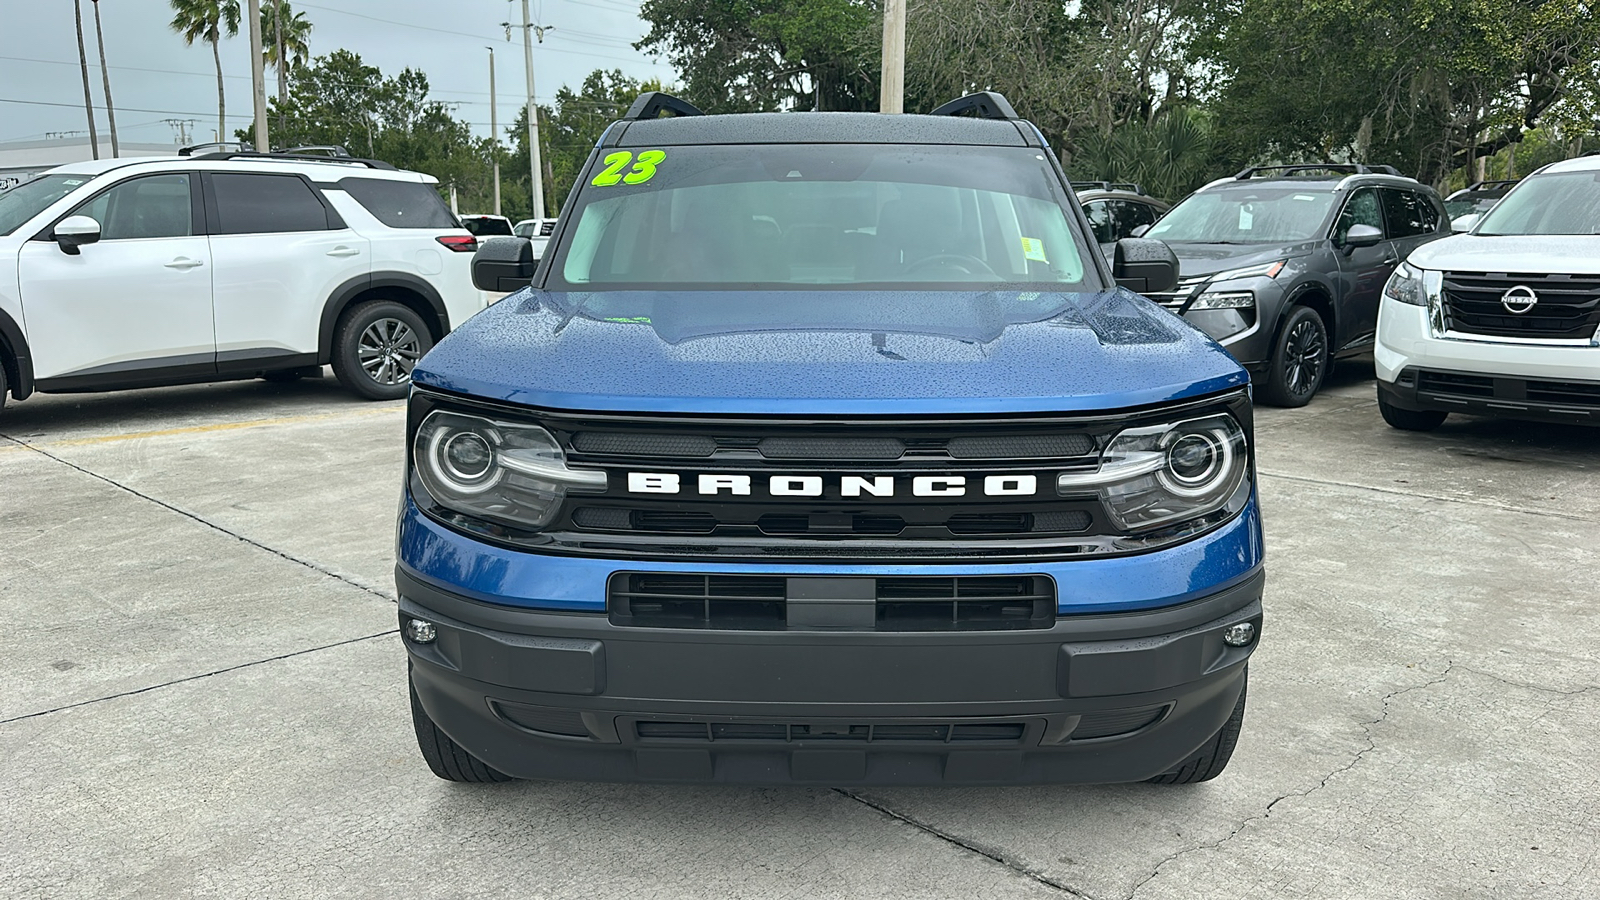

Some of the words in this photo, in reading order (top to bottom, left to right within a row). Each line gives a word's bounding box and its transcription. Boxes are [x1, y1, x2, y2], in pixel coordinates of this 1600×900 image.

[591, 150, 667, 187] 23
[1501, 296, 1538, 304] NISSAN
[627, 472, 1037, 497] BRONCO
